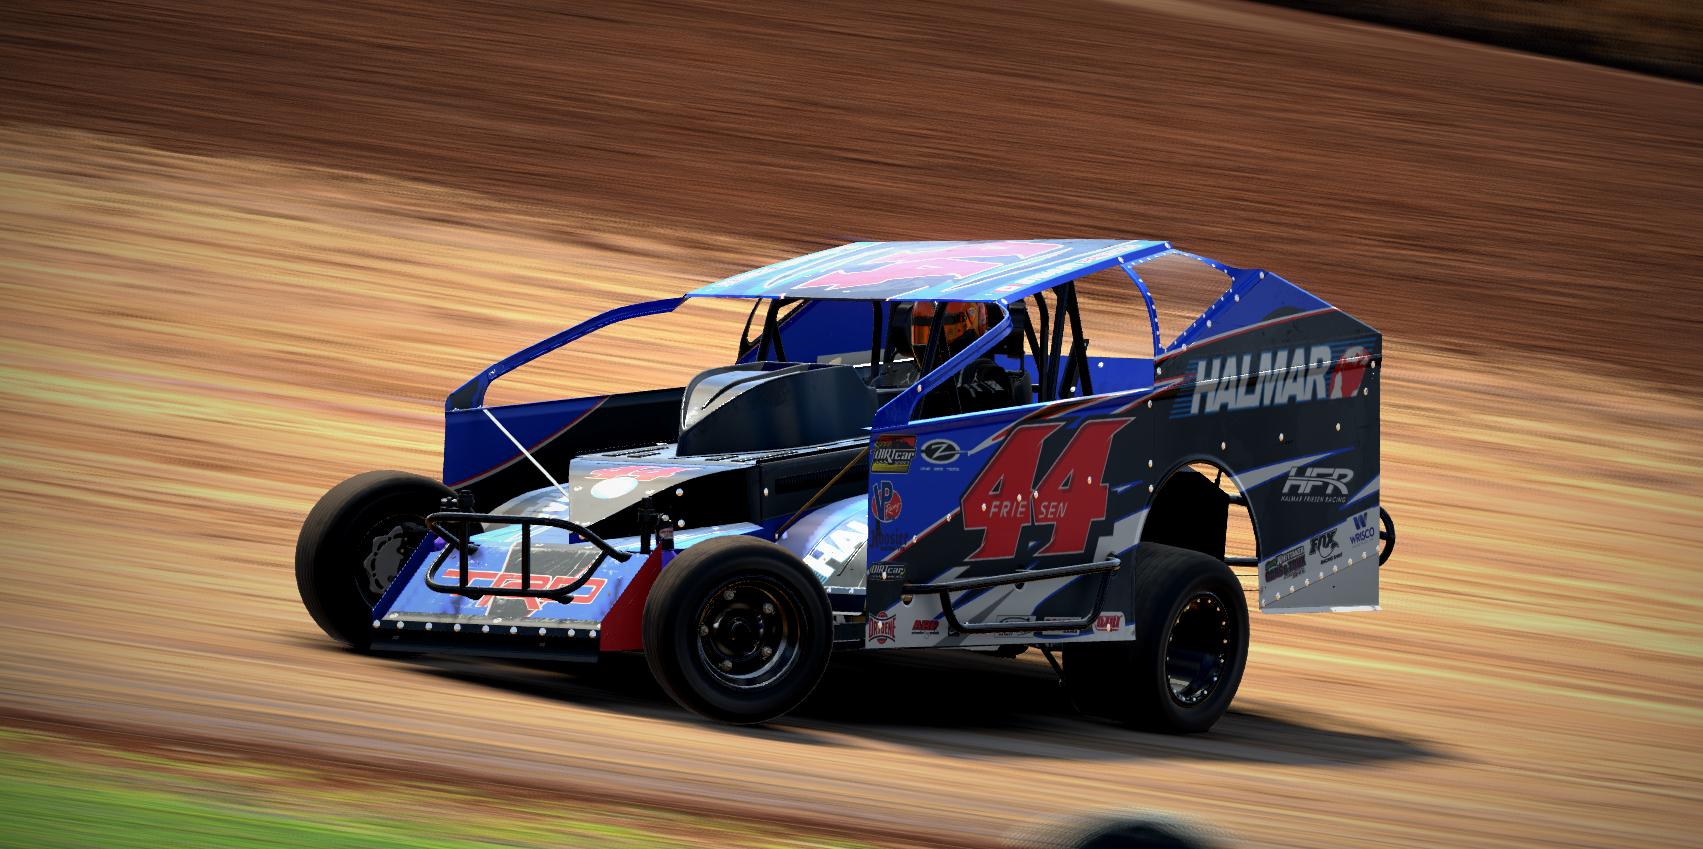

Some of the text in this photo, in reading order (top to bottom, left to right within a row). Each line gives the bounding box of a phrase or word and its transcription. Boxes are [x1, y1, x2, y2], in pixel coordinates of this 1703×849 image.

[1190, 345, 1332, 415] HALMAR
[961, 418, 1133, 562] 44
[1282, 466, 1354, 495] HFR
[1349, 527, 1375, 545] WRISCO
